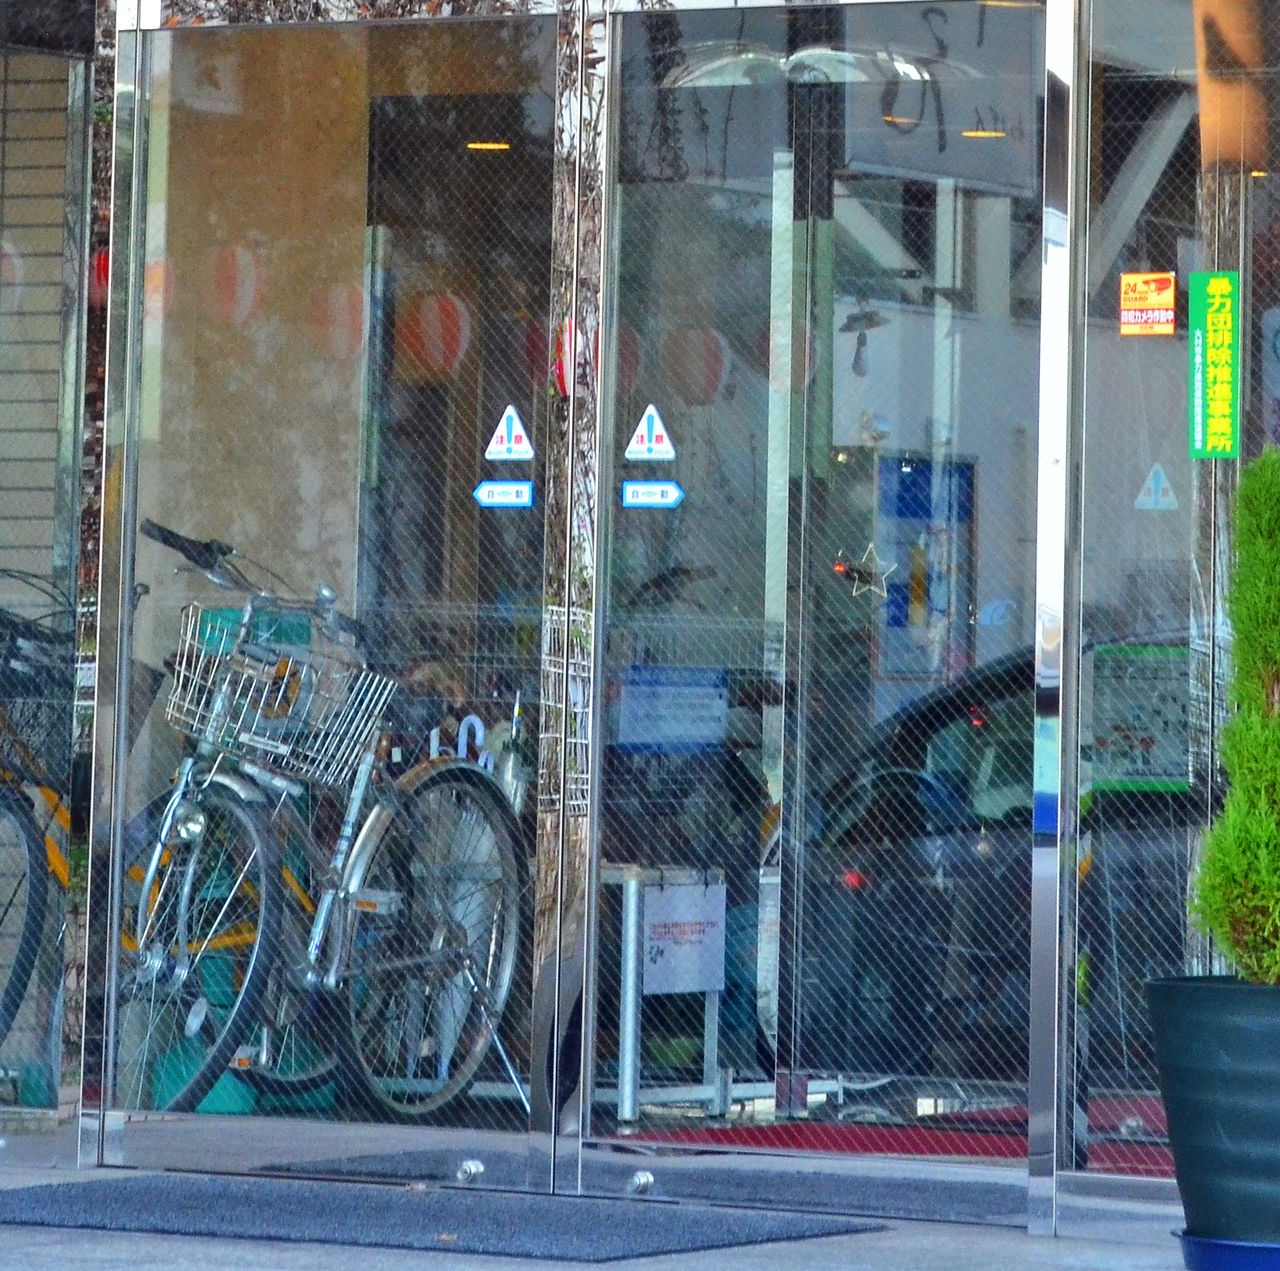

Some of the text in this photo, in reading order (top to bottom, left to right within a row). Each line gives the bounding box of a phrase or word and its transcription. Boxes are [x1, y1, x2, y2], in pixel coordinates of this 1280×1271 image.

[1123, 282, 1137, 295] 24
[1206, 277, 1233, 453] 暴力団排除推進事業所
